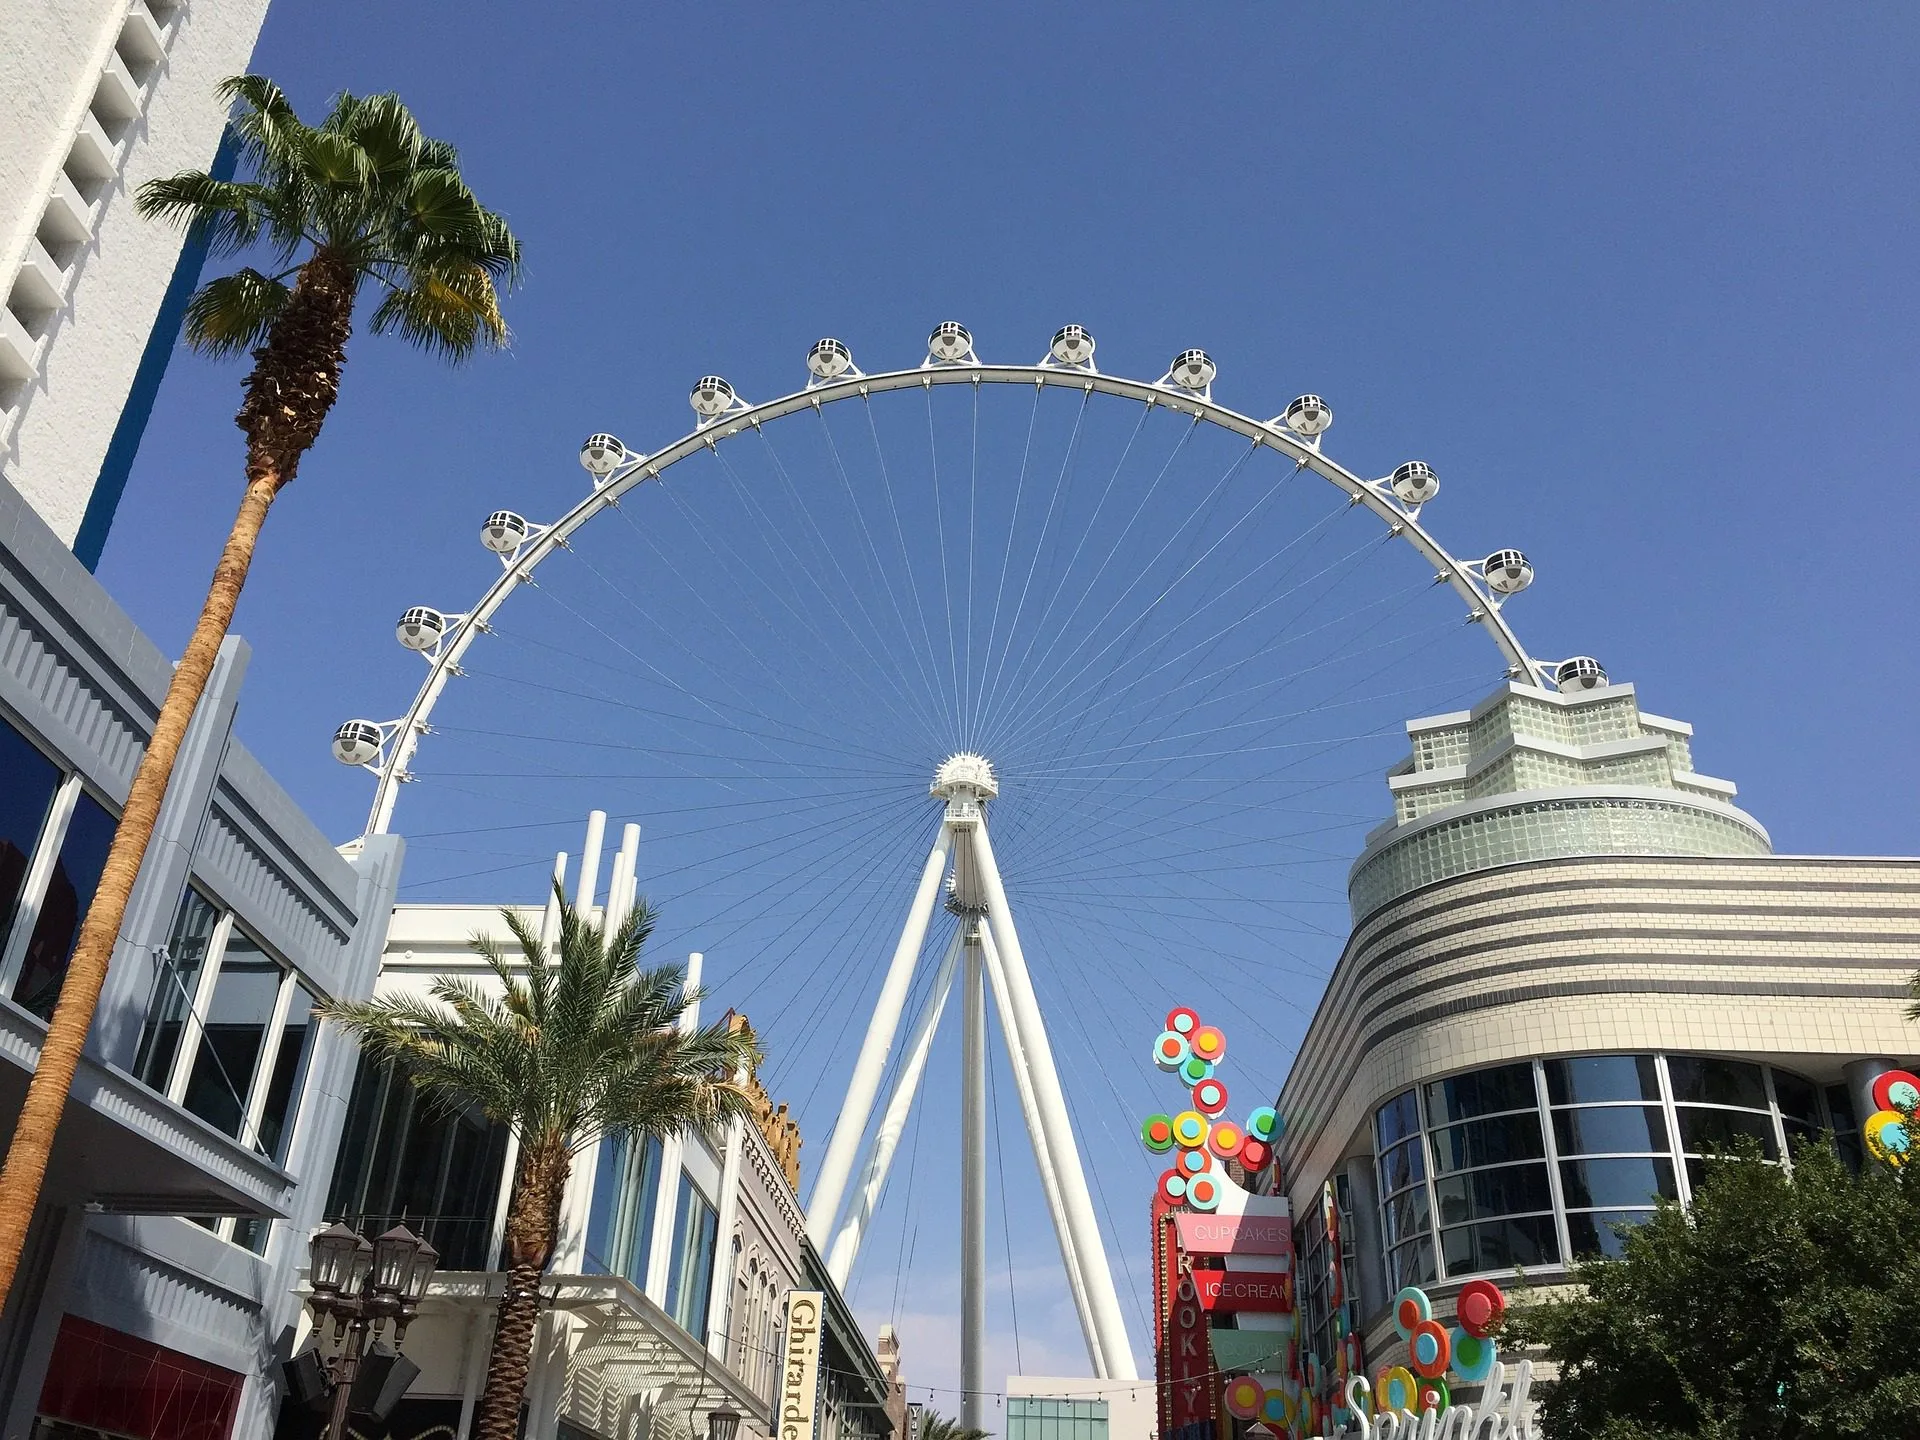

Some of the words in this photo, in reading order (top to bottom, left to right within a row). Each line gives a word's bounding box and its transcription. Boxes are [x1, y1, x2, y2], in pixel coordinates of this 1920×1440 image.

[1194, 1225, 1289, 1241] CUPCAKES
[1177, 1230, 1198, 1425] ROOKLY
[1206, 1282, 1232, 1297] ICE
[782, 1300, 817, 1440] Ghirarde
